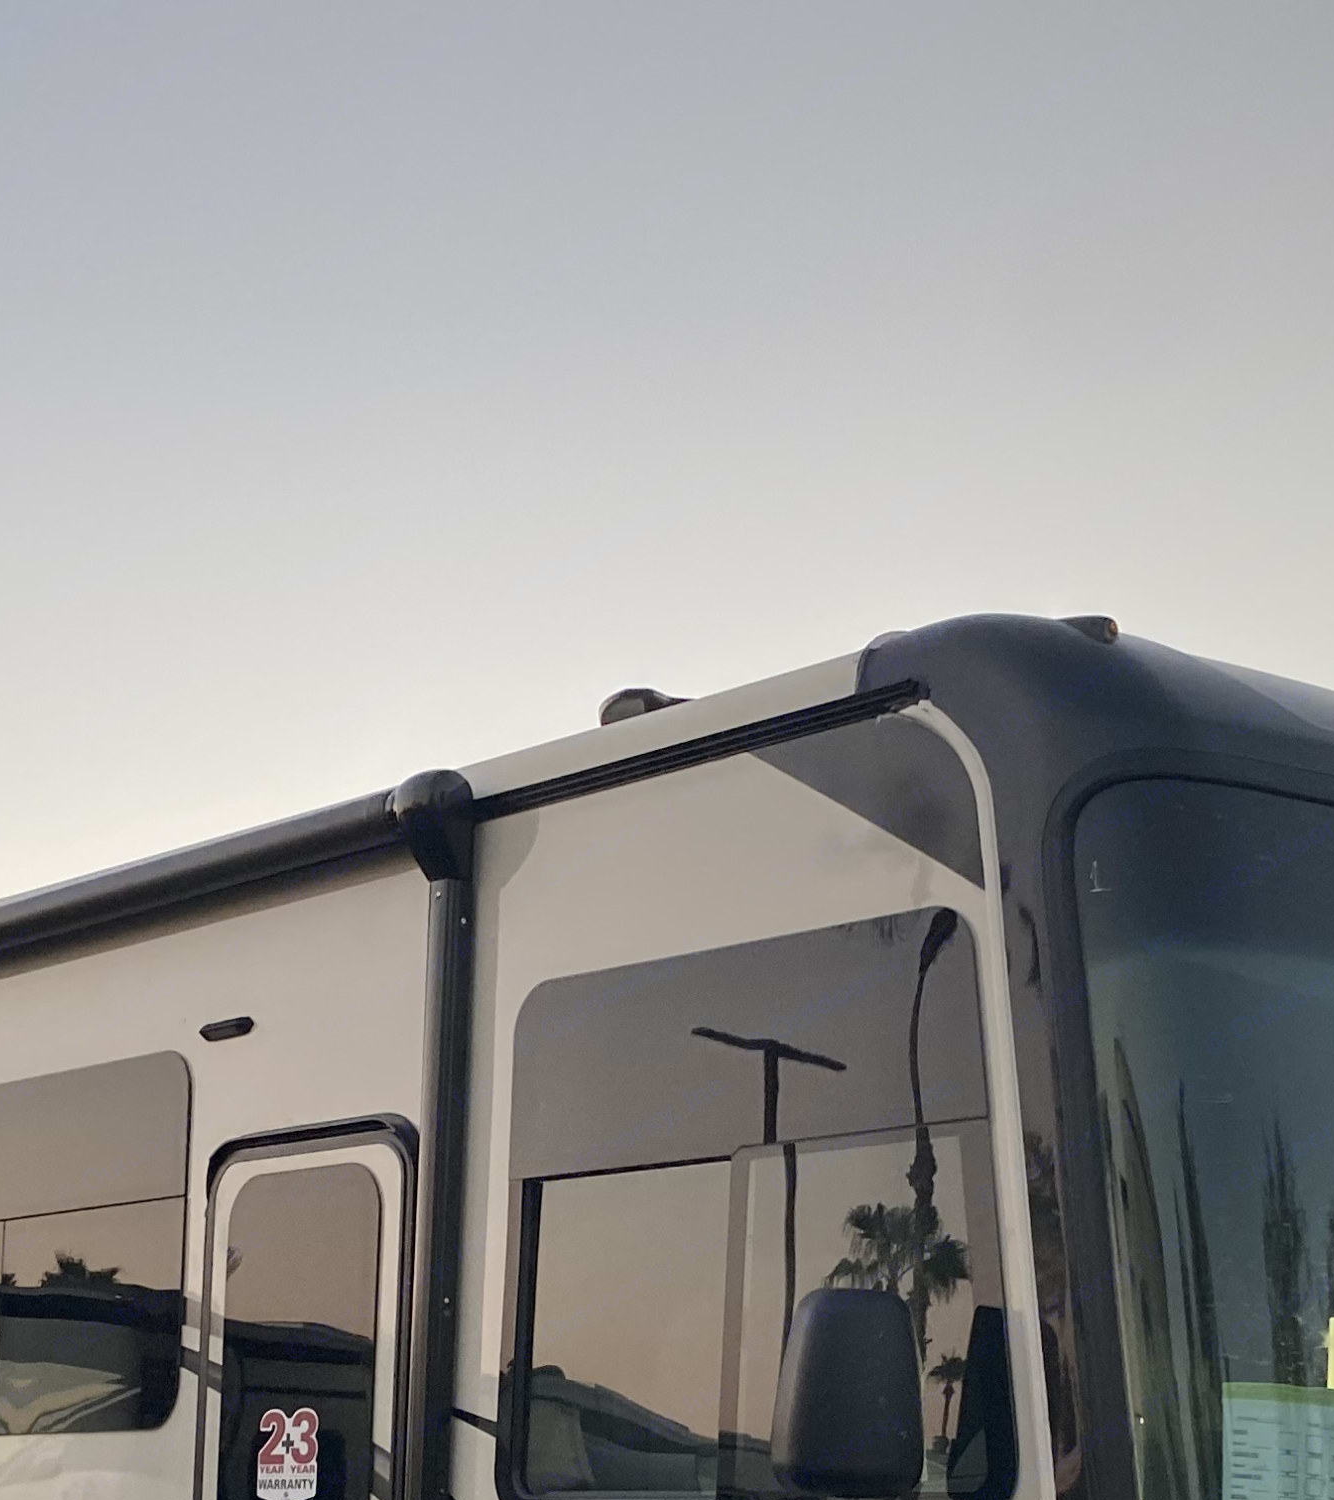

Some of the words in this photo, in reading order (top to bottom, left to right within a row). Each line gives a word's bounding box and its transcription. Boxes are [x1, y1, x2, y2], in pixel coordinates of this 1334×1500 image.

[260, 1465, 284, 1474] YEAR
[290, 1465, 315, 1473] YEAR
[259, 1479, 314, 1490] WARRANTY
